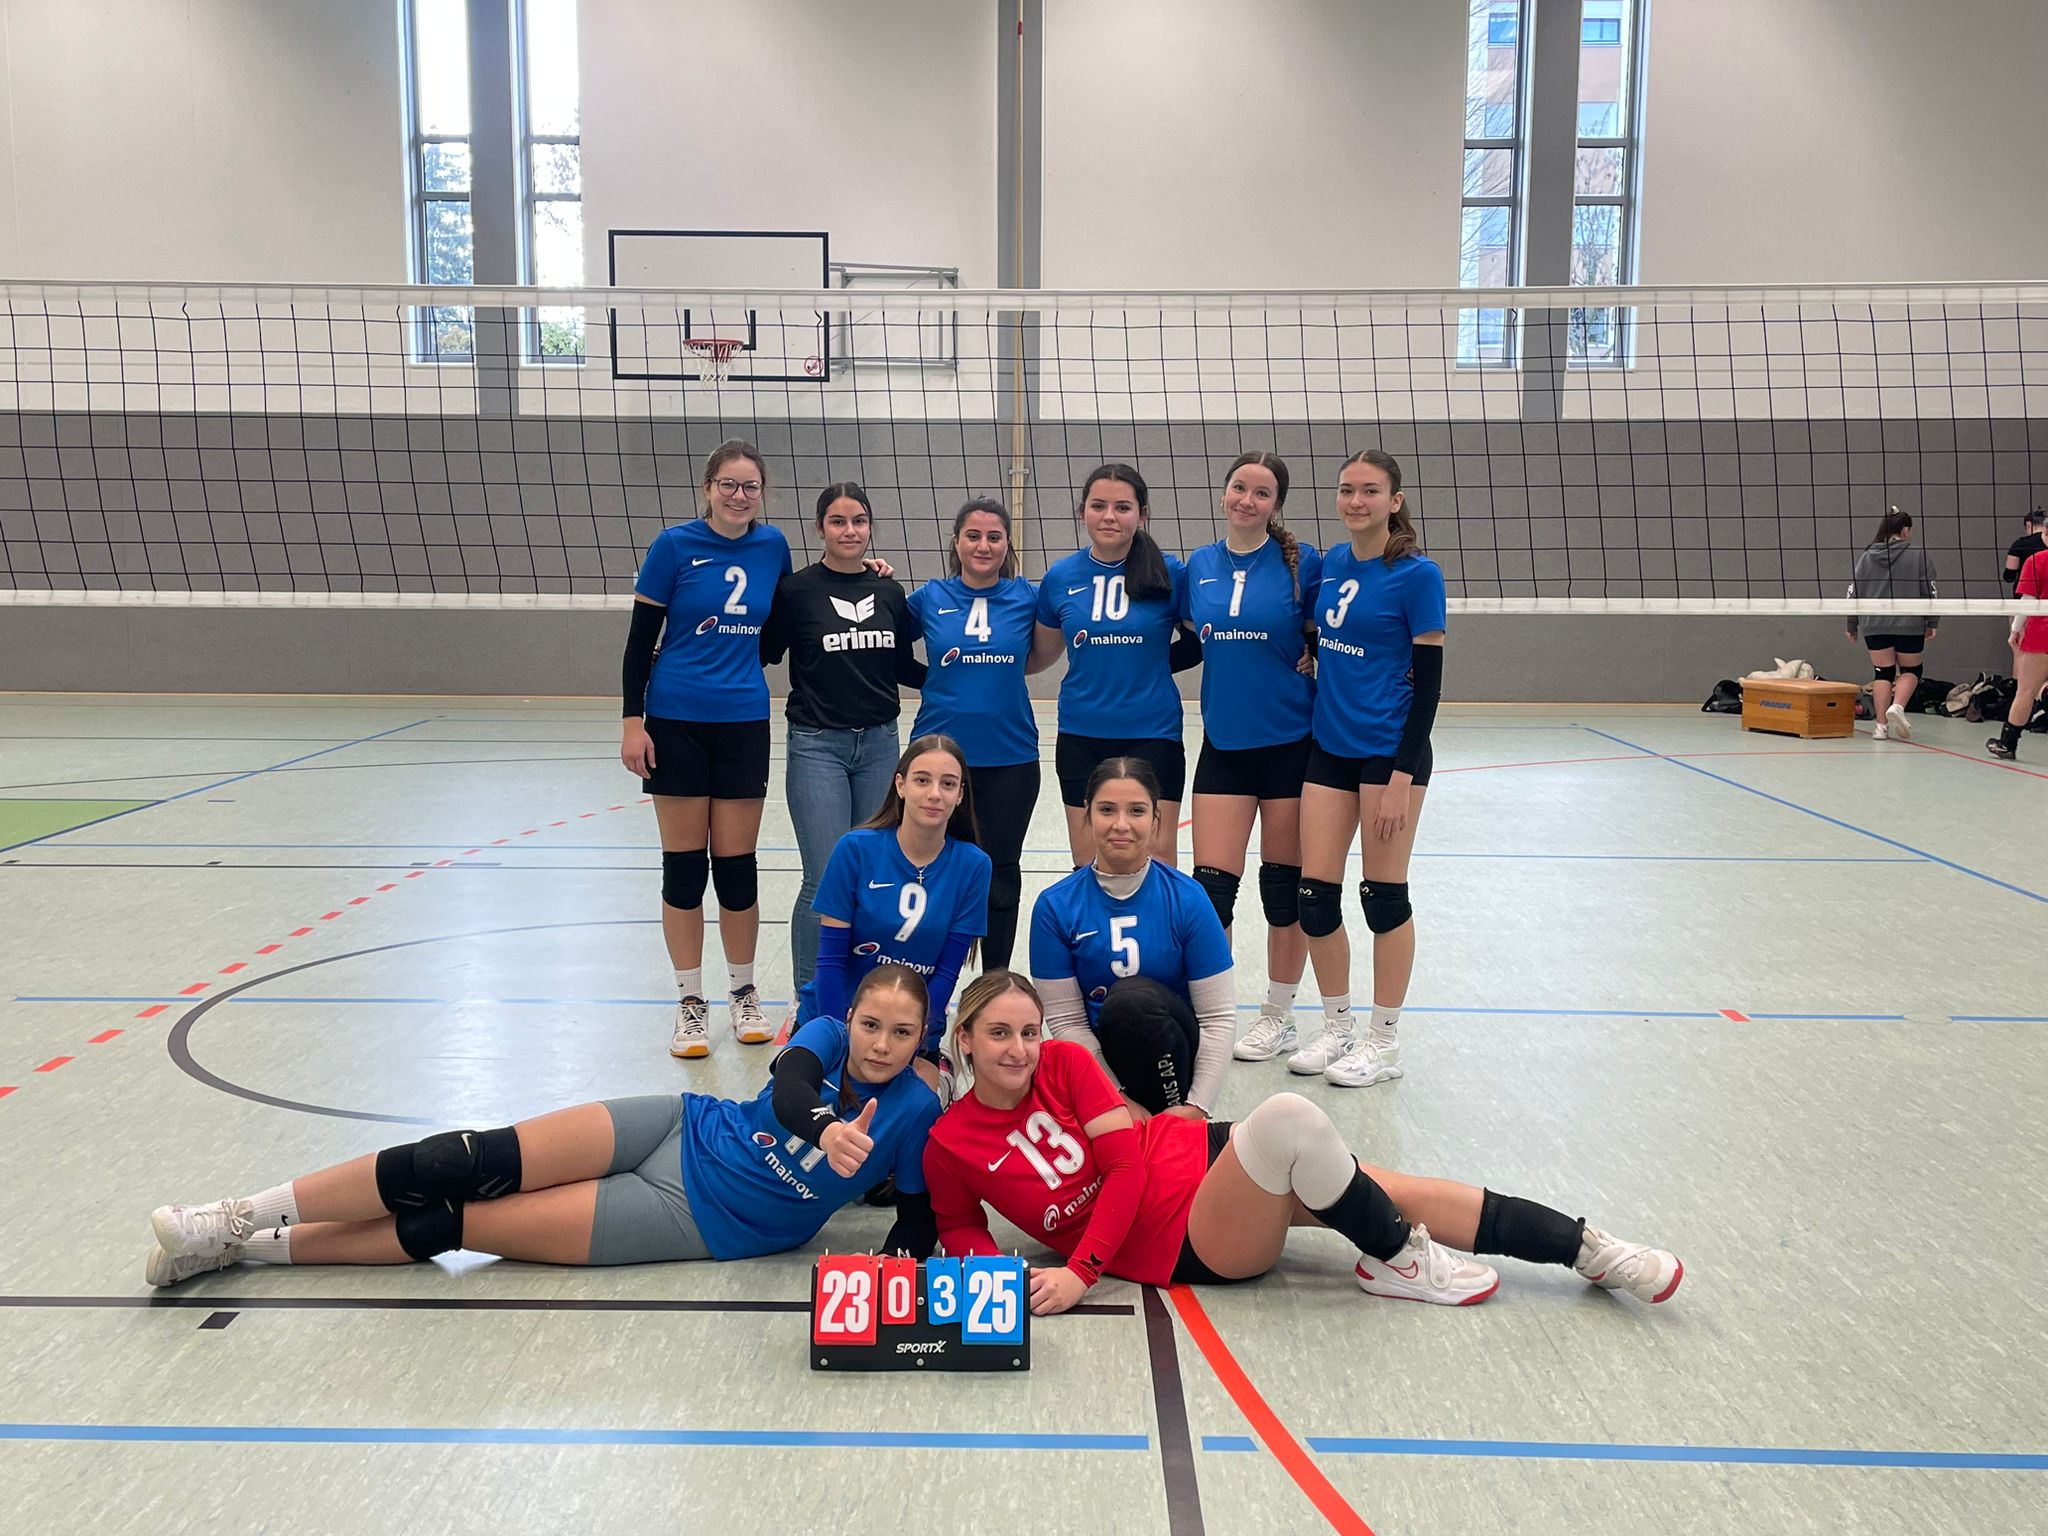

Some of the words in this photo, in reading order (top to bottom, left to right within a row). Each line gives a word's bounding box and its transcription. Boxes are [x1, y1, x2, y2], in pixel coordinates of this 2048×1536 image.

[723, 565, 748, 615] 2
[1091, 575, 1129, 622] 10
[1228, 570, 1247, 617] 1
[1325, 578, 1360, 629] 3
[822, 626, 895, 652] erima
[964, 597, 992, 642] 4
[1090, 633, 1143, 645] mainova
[1213, 628, 1268, 641] mainova
[962, 652, 1015, 664] mainova
[1319, 637, 1365, 657] mainova
[894, 881, 928, 942] 9
[1109, 915, 1140, 978] 5
[1005, 1110, 1085, 1191] 13
[764, 1151, 820, 1200] mainov
[819, 1269, 871, 1334] 23
[888, 1275, 910, 1319] 0
[933, 1274, 957, 1318] 3
[967, 1270, 1017, 1334] 25
[895, 1340, 947, 1354] SPORTX
